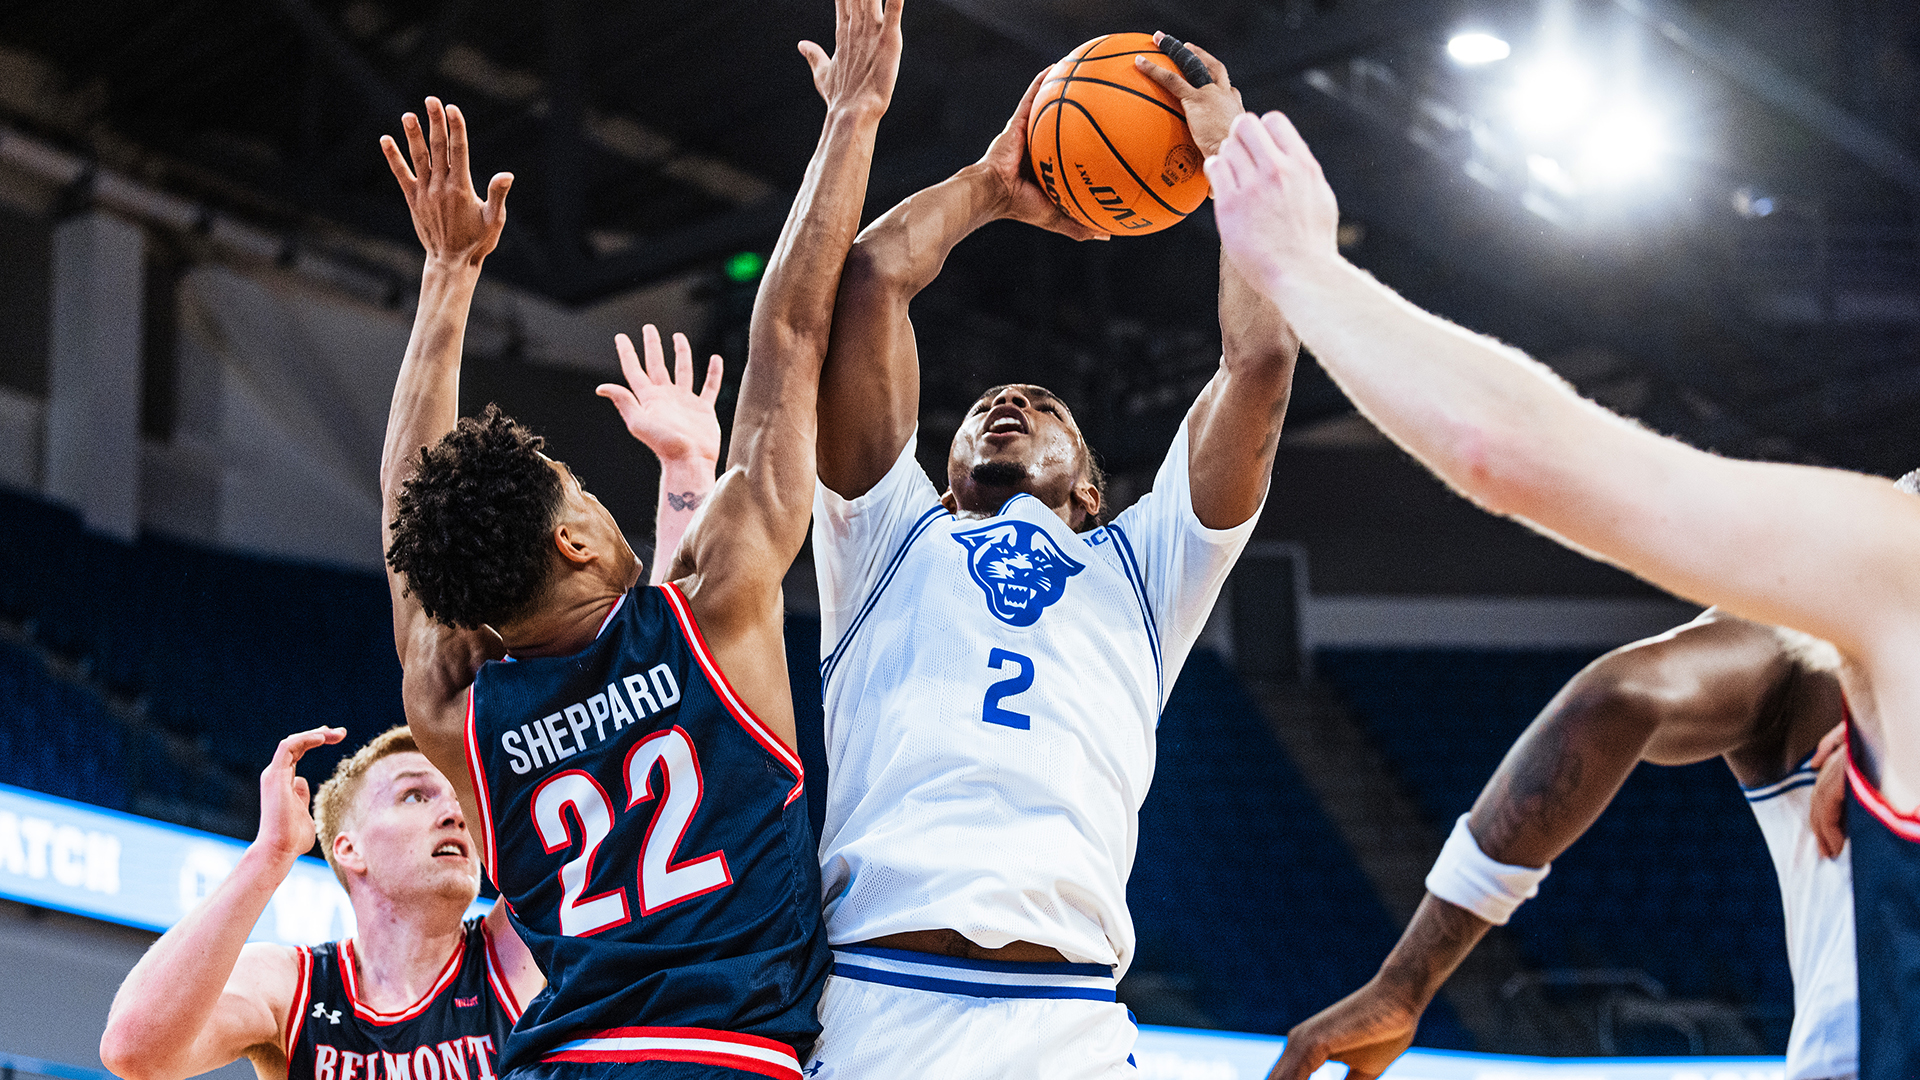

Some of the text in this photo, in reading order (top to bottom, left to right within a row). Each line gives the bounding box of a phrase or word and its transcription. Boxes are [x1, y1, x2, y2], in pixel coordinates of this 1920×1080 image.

[1074, 162, 1153, 230] EVO NXT
[501, 663, 681, 775] SHEPPARD
[982, 647, 1035, 730] 2
[530, 724, 734, 938] 22
[314, 1033, 498, 1080] BELMONT
